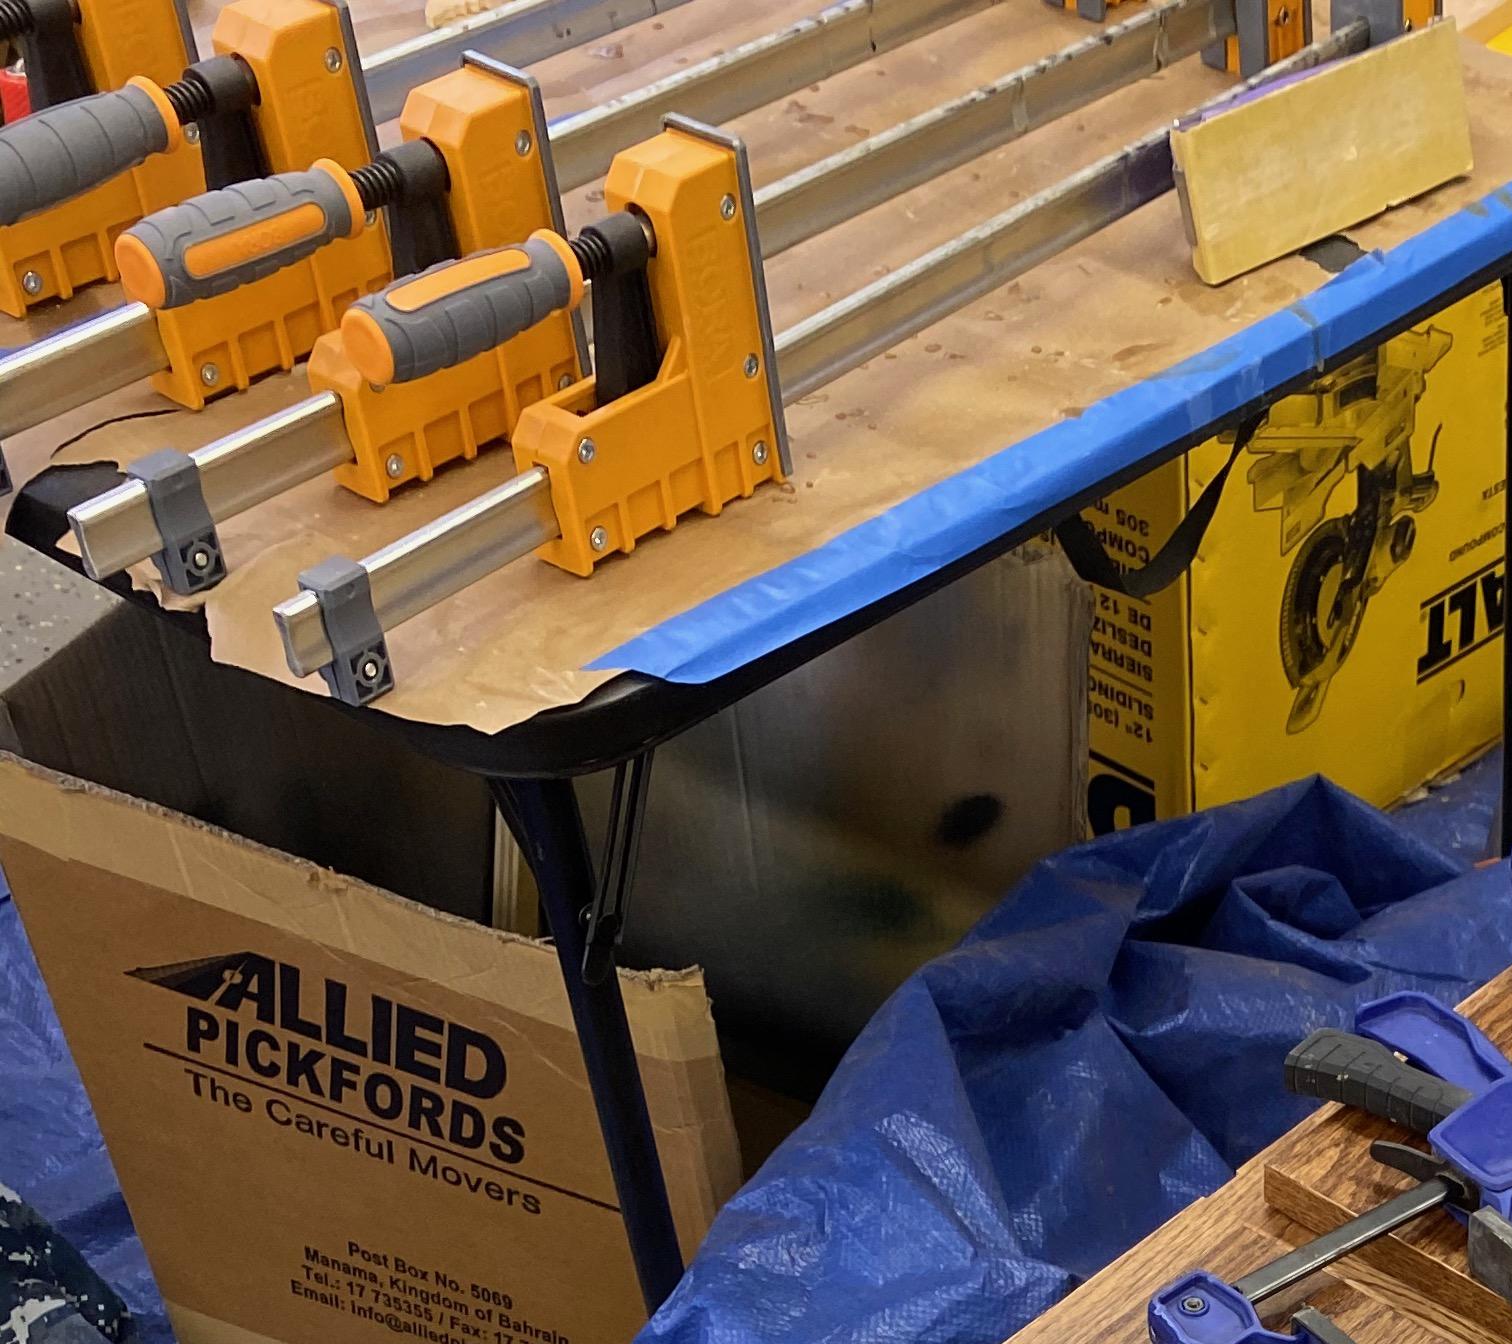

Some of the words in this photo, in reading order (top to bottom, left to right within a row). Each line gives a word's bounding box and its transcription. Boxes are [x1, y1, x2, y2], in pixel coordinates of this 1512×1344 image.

[1116, 508, 1150, 537] 305
[1449, 522, 1506, 561] COMPOUND
[1100, 592, 1120, 615] 12
[1127, 605, 1152, 631] DE
[1091, 640, 1153, 682] SIERRA
[214, 951, 507, 1099] ALLIED
[187, 1006, 526, 1164] PICKFORDS
[184, 1068, 252, 1113] The
[266, 1099, 394, 1165] Careful
[408, 1147, 541, 1215] Movers
[290, 1279, 347, 1311] Email:
[304, 1246, 384, 1289] Manama,
[389, 1275, 469, 1316] Kingdom
[475, 1309, 493, 1323] of
[348, 1241, 389, 1269] Post
[394, 1257, 429, 1282] Box
[435, 1271, 465, 1295] No.
[470, 1283, 513, 1310] 5069
[346, 1281, 366, 1298] 17
[371, 1289, 434, 1323] 735355
[438, 1311, 444, 1326] /
[450, 1315, 488, 1340] Fax:
